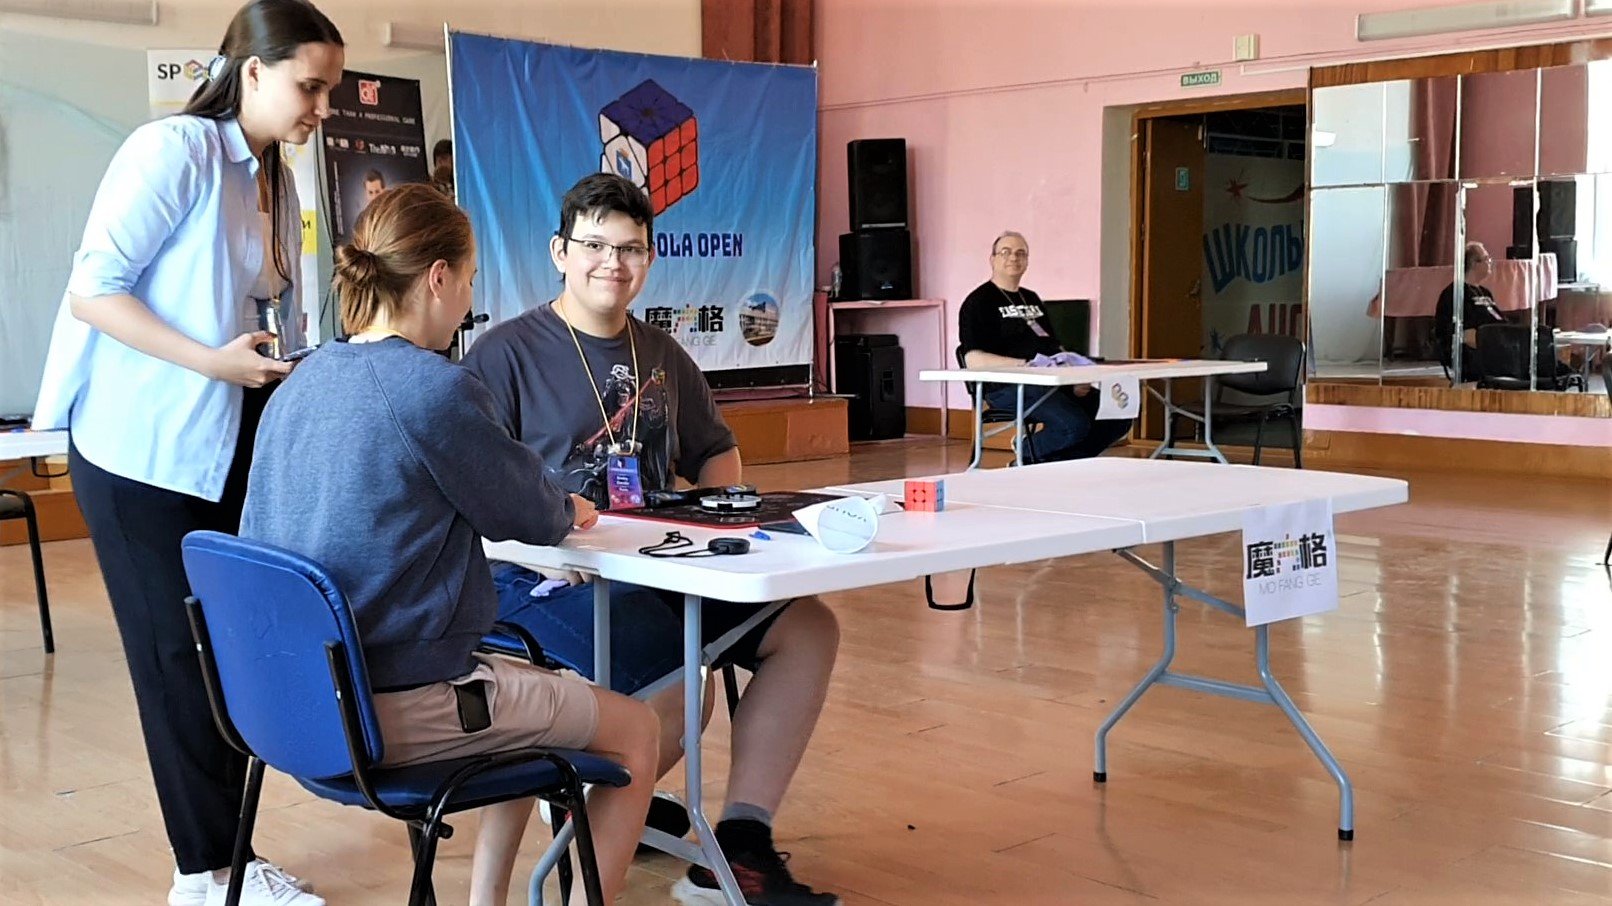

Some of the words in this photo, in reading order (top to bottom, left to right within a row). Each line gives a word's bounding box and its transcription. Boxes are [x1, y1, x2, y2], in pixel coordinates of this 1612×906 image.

[1183, 73, 1218, 85] ВЫХОД
[656, 232, 693, 258] OLA
[697, 232, 743, 257] OPEN
[1203, 220, 1305, 295] ШКОЛЬ
[1278, 575, 1304, 592] FANG
[1306, 572, 1323, 588] GE
